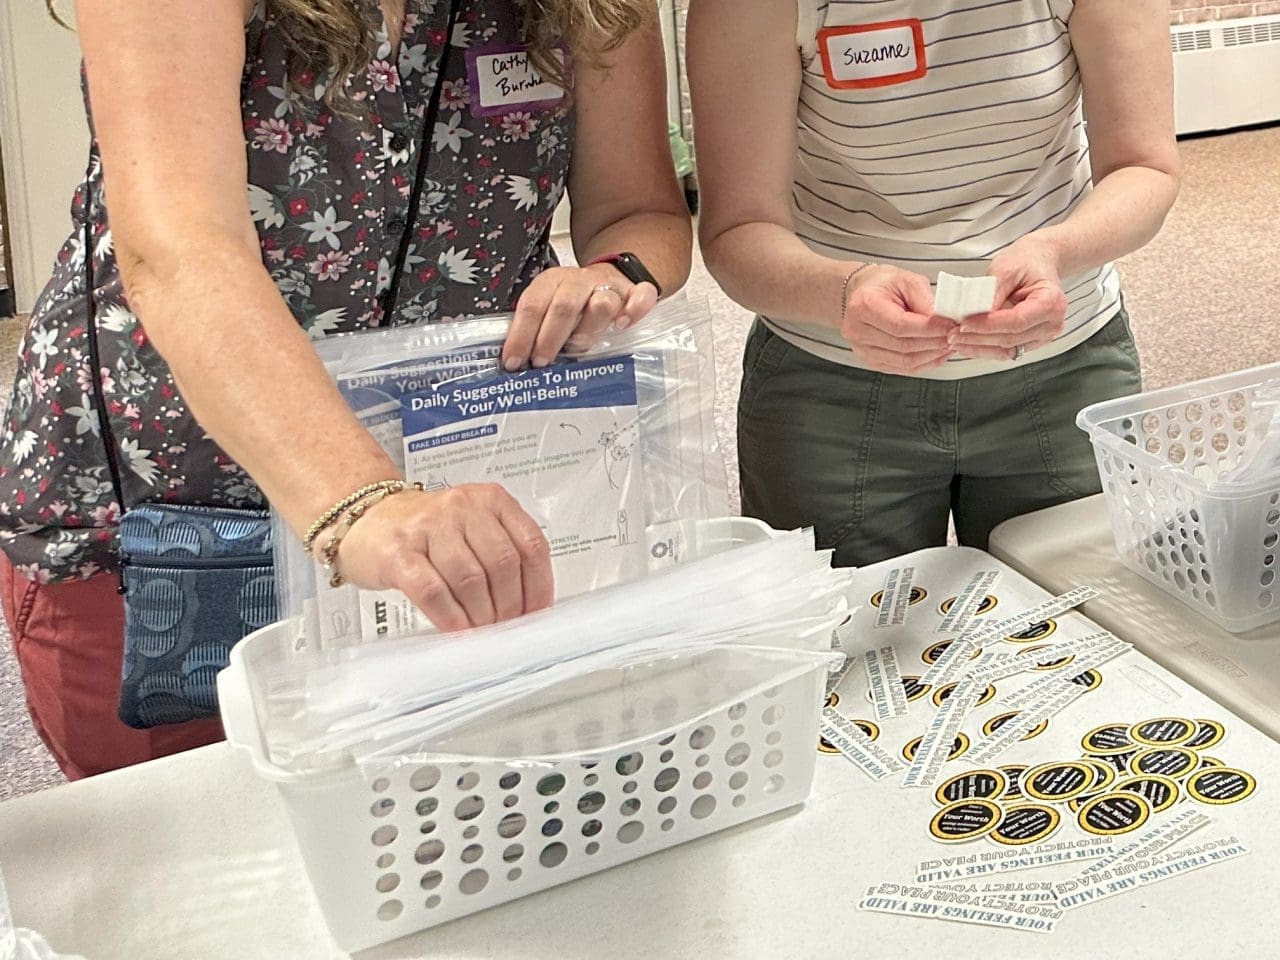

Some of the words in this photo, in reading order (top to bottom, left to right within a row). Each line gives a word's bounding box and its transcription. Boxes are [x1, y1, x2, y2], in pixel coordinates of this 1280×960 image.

[843, 42, 910, 65] Suzanne
[411, 393, 450, 411] Daily
[453, 373, 540, 402] Suggestions
[543, 371, 562, 386] To
[564, 360, 625, 383] Improve
[458, 395, 496, 416] Your
[497, 383, 579, 409] Well-Being
[410, 441, 430, 451] TAKE
[431, 439, 441, 447] 10
[441, 434, 460, 445] DEEP
[978, 847, 1031, 861] YOUR
[1032, 836, 1113, 854] PROTECT
[1075, 846, 1113, 858] YOUR
[1165, 835, 1237, 862] PROTECT
[1207, 844, 1245, 861] YOUR
[919, 854, 977, 870] PEACE
[964, 863, 996, 875] ARE
[999, 852, 1073, 870] FEELINGS
[1112, 855, 1163, 877] YOUR
[1137, 854, 1207, 882] FEELINGS
[916, 868, 961, 883] VALID
[1055, 869, 1113, 894] PEACE
[1106, 876, 1136, 893] ARE
[876, 882, 933, 900] PEACE
[931, 889, 982, 907] YOUR
[1059, 886, 1104, 908] VALID
[864, 896, 909, 912] VALID
[910, 901, 940, 916] ARE
[981, 898, 1063, 919] PROTECT
[943, 906, 1014, 925] FEELINGS
[1013, 917, 1054, 930] YOUR
